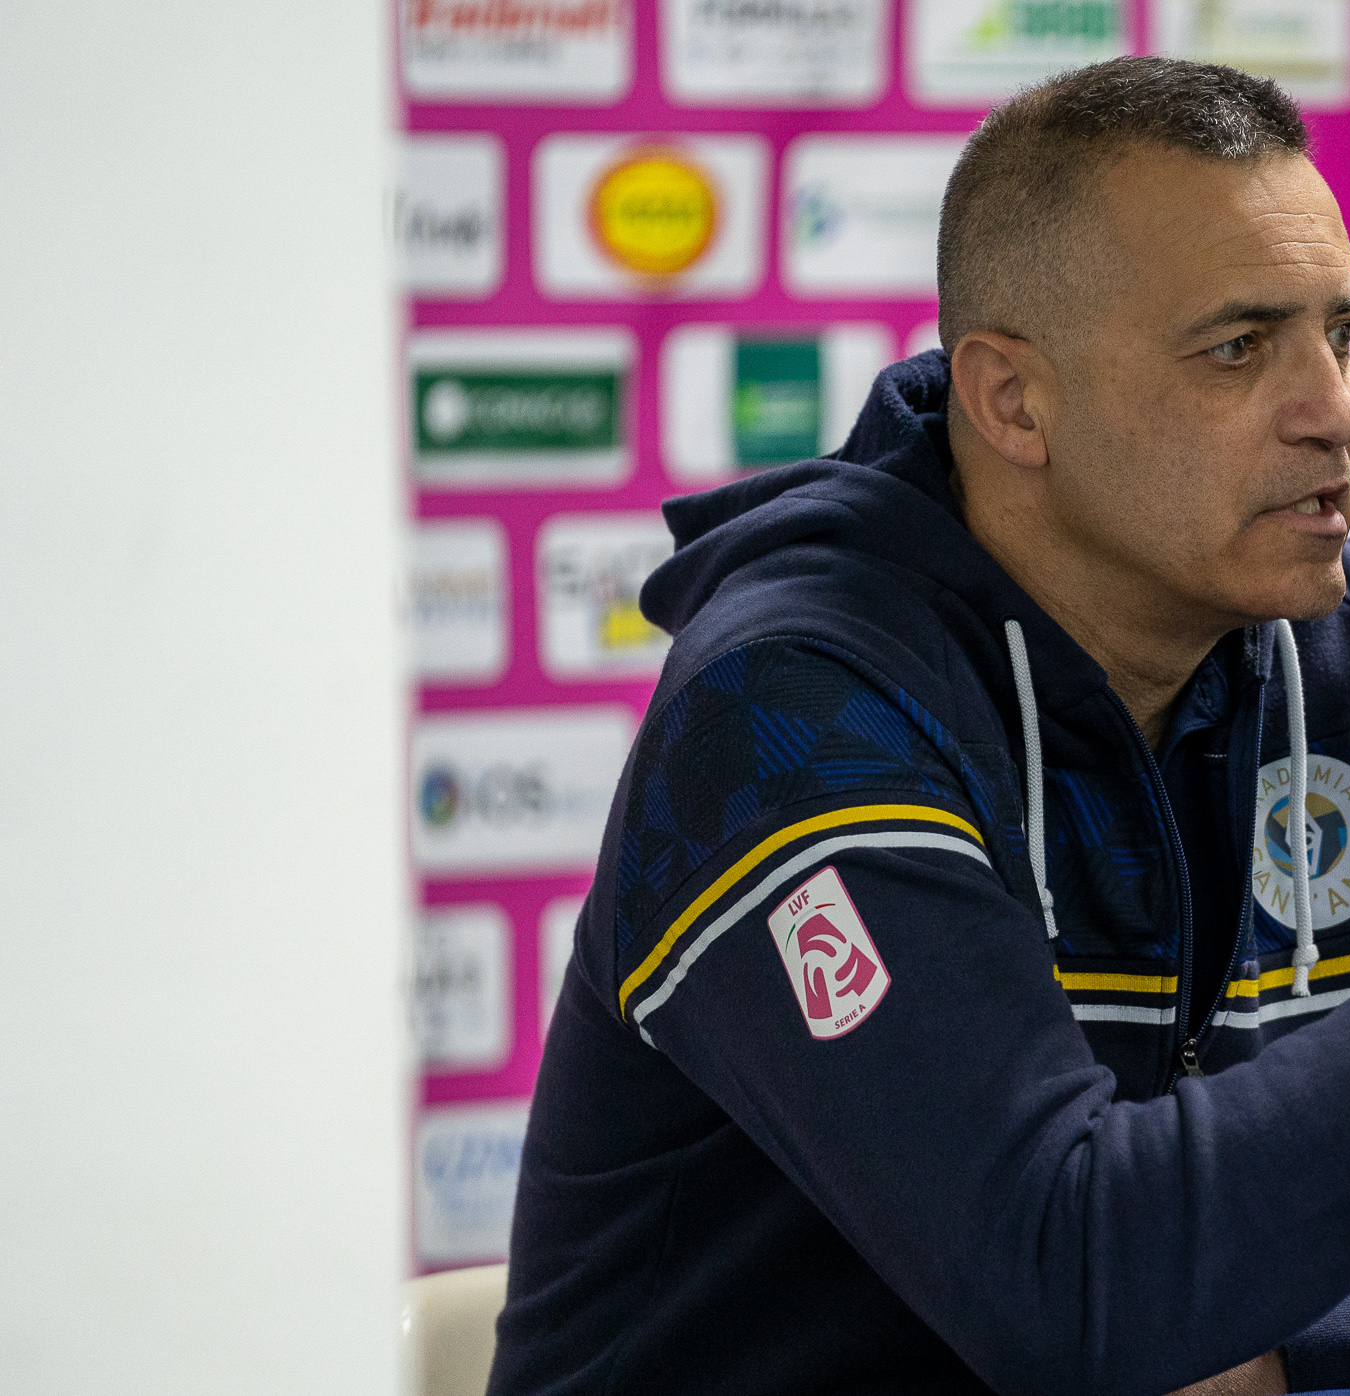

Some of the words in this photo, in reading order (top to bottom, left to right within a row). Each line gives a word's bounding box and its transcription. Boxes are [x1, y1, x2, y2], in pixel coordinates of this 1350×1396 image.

[787, 889, 811, 917] LVF
[834, 1008, 859, 1030] SERIE
[858, 1003, 867, 1013] A
